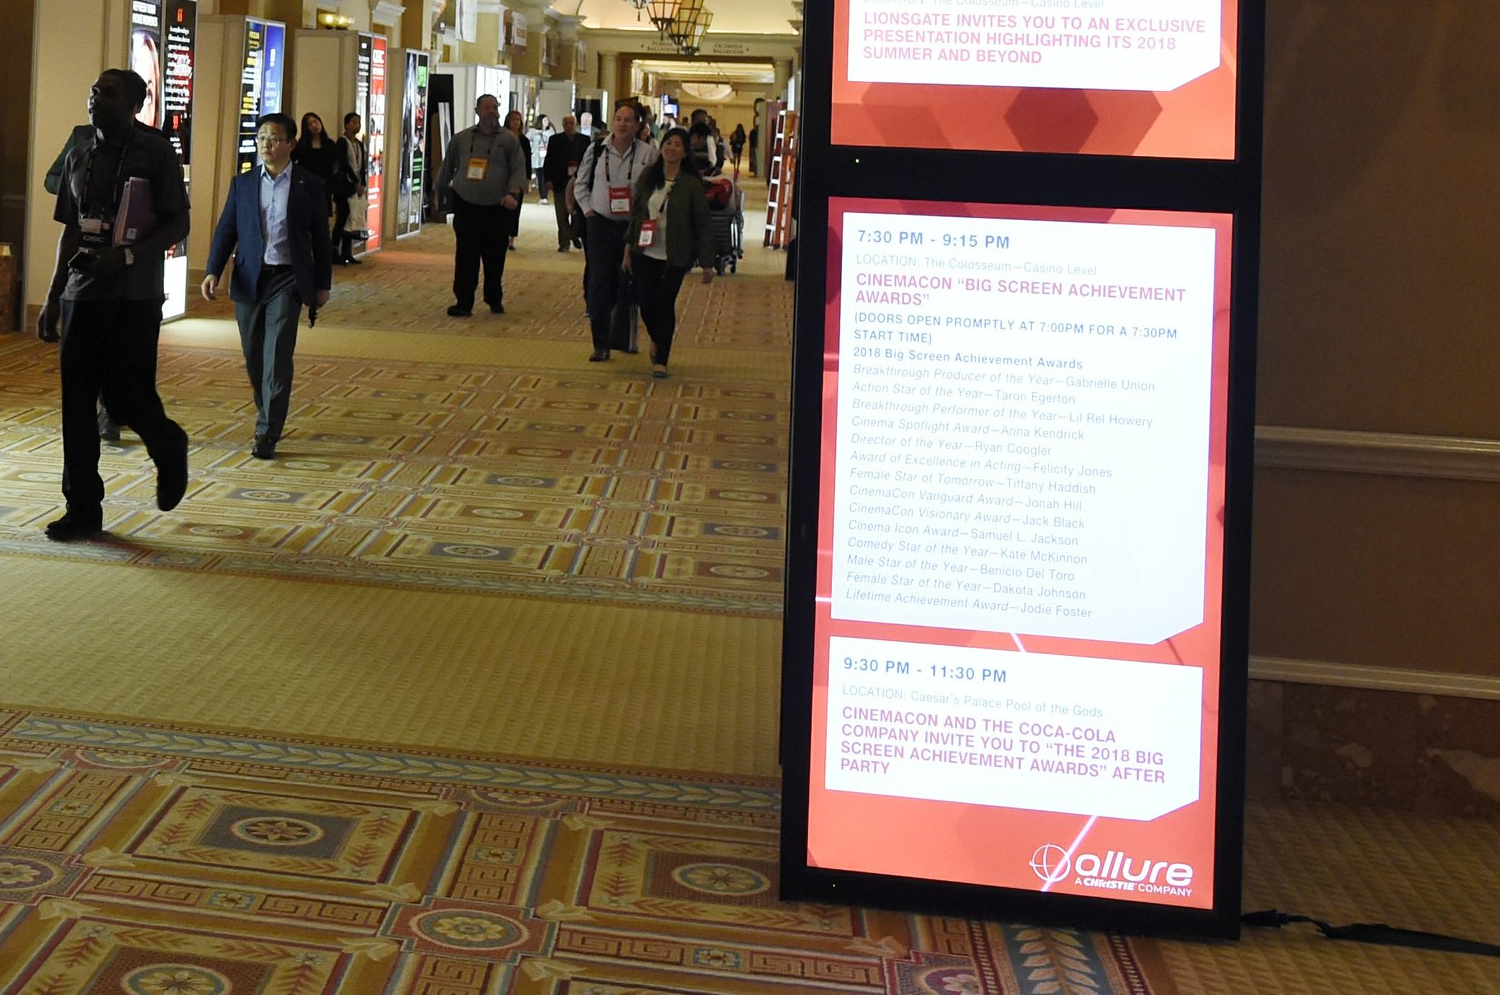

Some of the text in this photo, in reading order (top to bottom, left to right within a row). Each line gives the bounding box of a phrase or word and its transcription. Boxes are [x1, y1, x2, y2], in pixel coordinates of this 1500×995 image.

[864, 12, 1204, 33] LIONSGATE INVITES YOU TO AN EXCLUSIVE
[864, 29, 1176, 49] PRESENTATION HIGHLIGHTING ITS 2018
[864, 46, 1042, 63] SUMMER AND BEYOND
[858, 230, 892, 243] 7:30
[900, 231, 922, 244] PM
[943, 234, 977, 247] 9:15
[985, 235, 1009, 249] PM
[857, 273, 952, 289] CINEMACON
[998, 280, 1062, 295] SCREEN
[1068, 284, 1186, 301] ACHIEVEMENT
[854, 329, 932, 345] START TIME)
[855, 313, 1177, 339] (DOORS OPEN PROMPTLY AT 7:00PM FOR A 7:30PM
[854, 347, 1082, 369] 2018 Big Screen Achievement Awards
[844, 657, 878, 671] 9:30
[886, 661, 909, 674] PM
[931, 665, 974, 680] 11:30
[982, 669, 1006, 682] PM
[843, 707, 1116, 743] CINEMACON AND THE COCA-COLA
[842, 724, 918, 742] COMPANY
[925, 731, 974, 747] INVITE
[981, 737, 1013, 751] YOU
[1020, 740, 1040, 753] TO
[1091, 747, 1130, 762] 2018
[1136, 751, 1163, 765] BIG
[841, 741, 904, 758] SCREEN
[910, 747, 1024, 769] ACHIEVEMENT
[1112, 767, 1164, 783] AFTER
[841, 758, 890, 774] PARTY
[1075, 850, 1193, 887] allure
[1074, 877, 1192, 897] A CHRISTIE COMPANY
